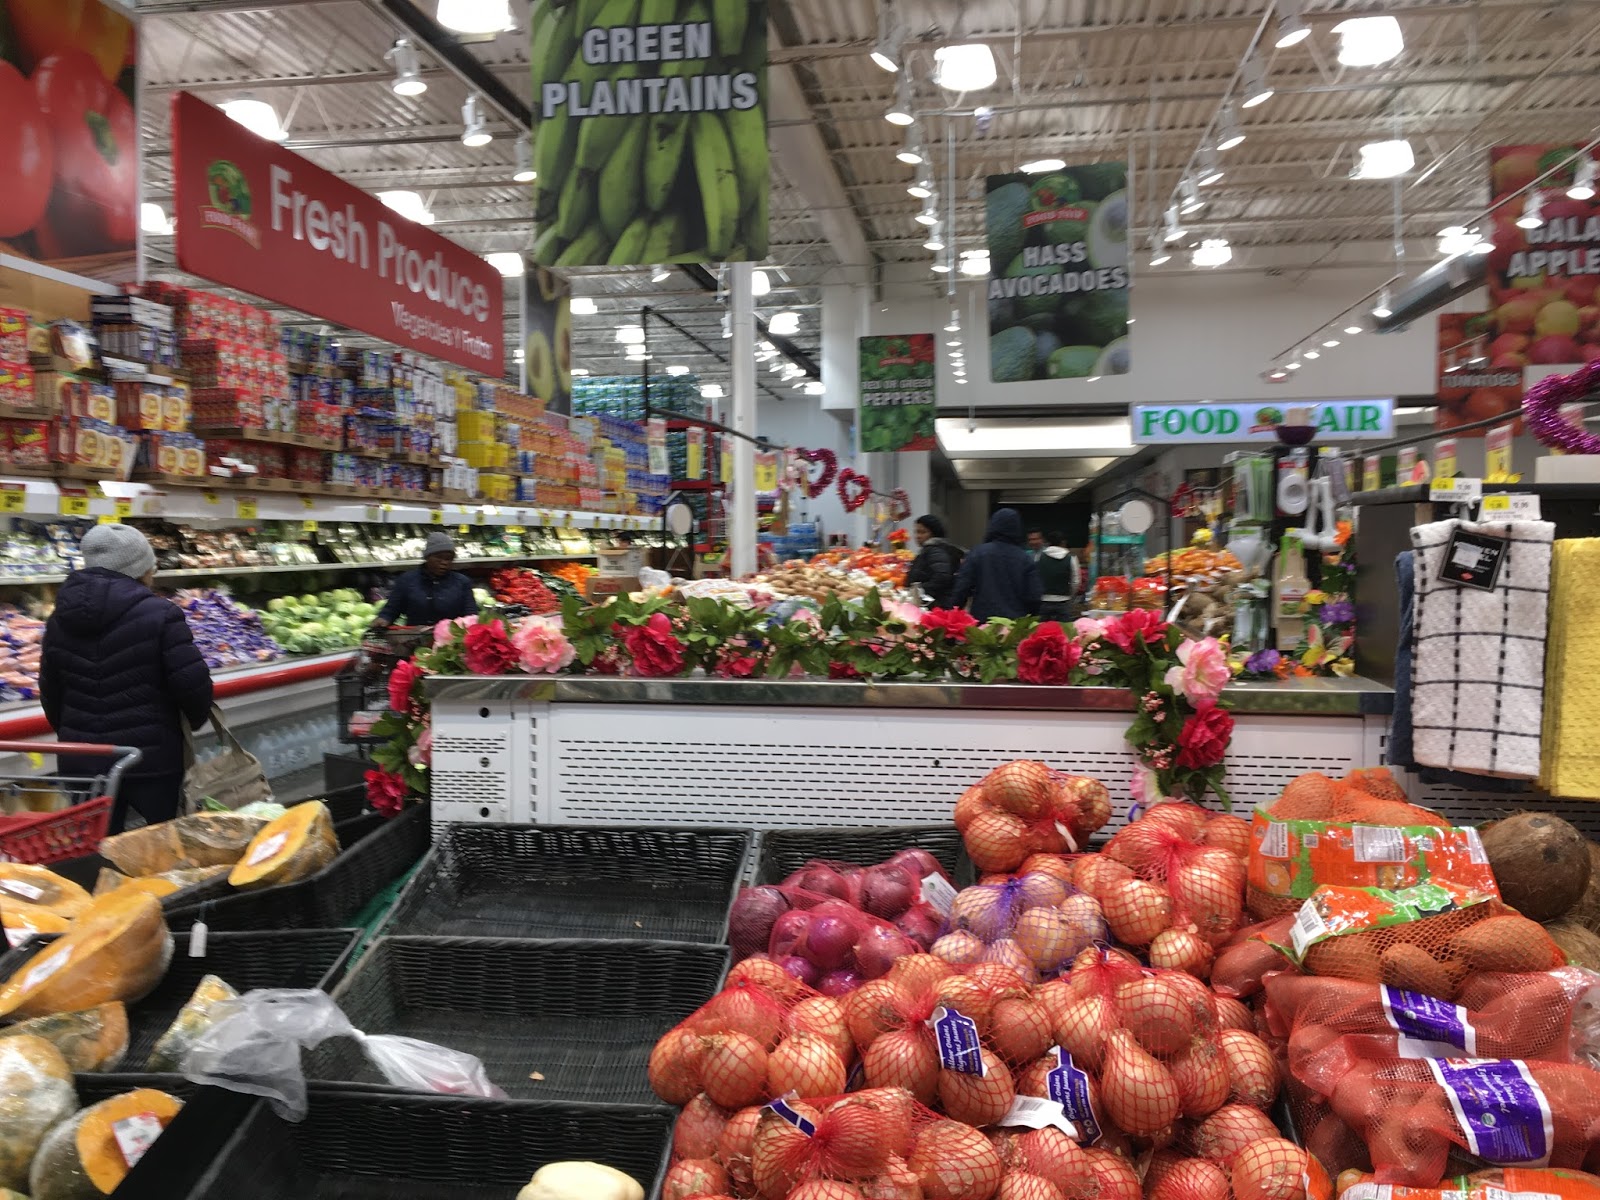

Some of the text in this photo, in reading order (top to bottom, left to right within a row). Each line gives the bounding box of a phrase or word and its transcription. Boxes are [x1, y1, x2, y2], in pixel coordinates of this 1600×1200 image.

[582, 22, 712, 65] GREEN
[542, 72, 759, 118] PLANTAINS
[269, 163, 489, 322] Fresh Produce
[1023, 241, 1088, 268] HASS
[988, 267, 1128, 300] AVOCADOES
[861, 390, 934, 406] PEPPERS
[1140, 405, 1382, 437] FOOD AIR
[942, 1024, 953, 1049] Onions
[1053, 1074, 1062, 1097] Onions
